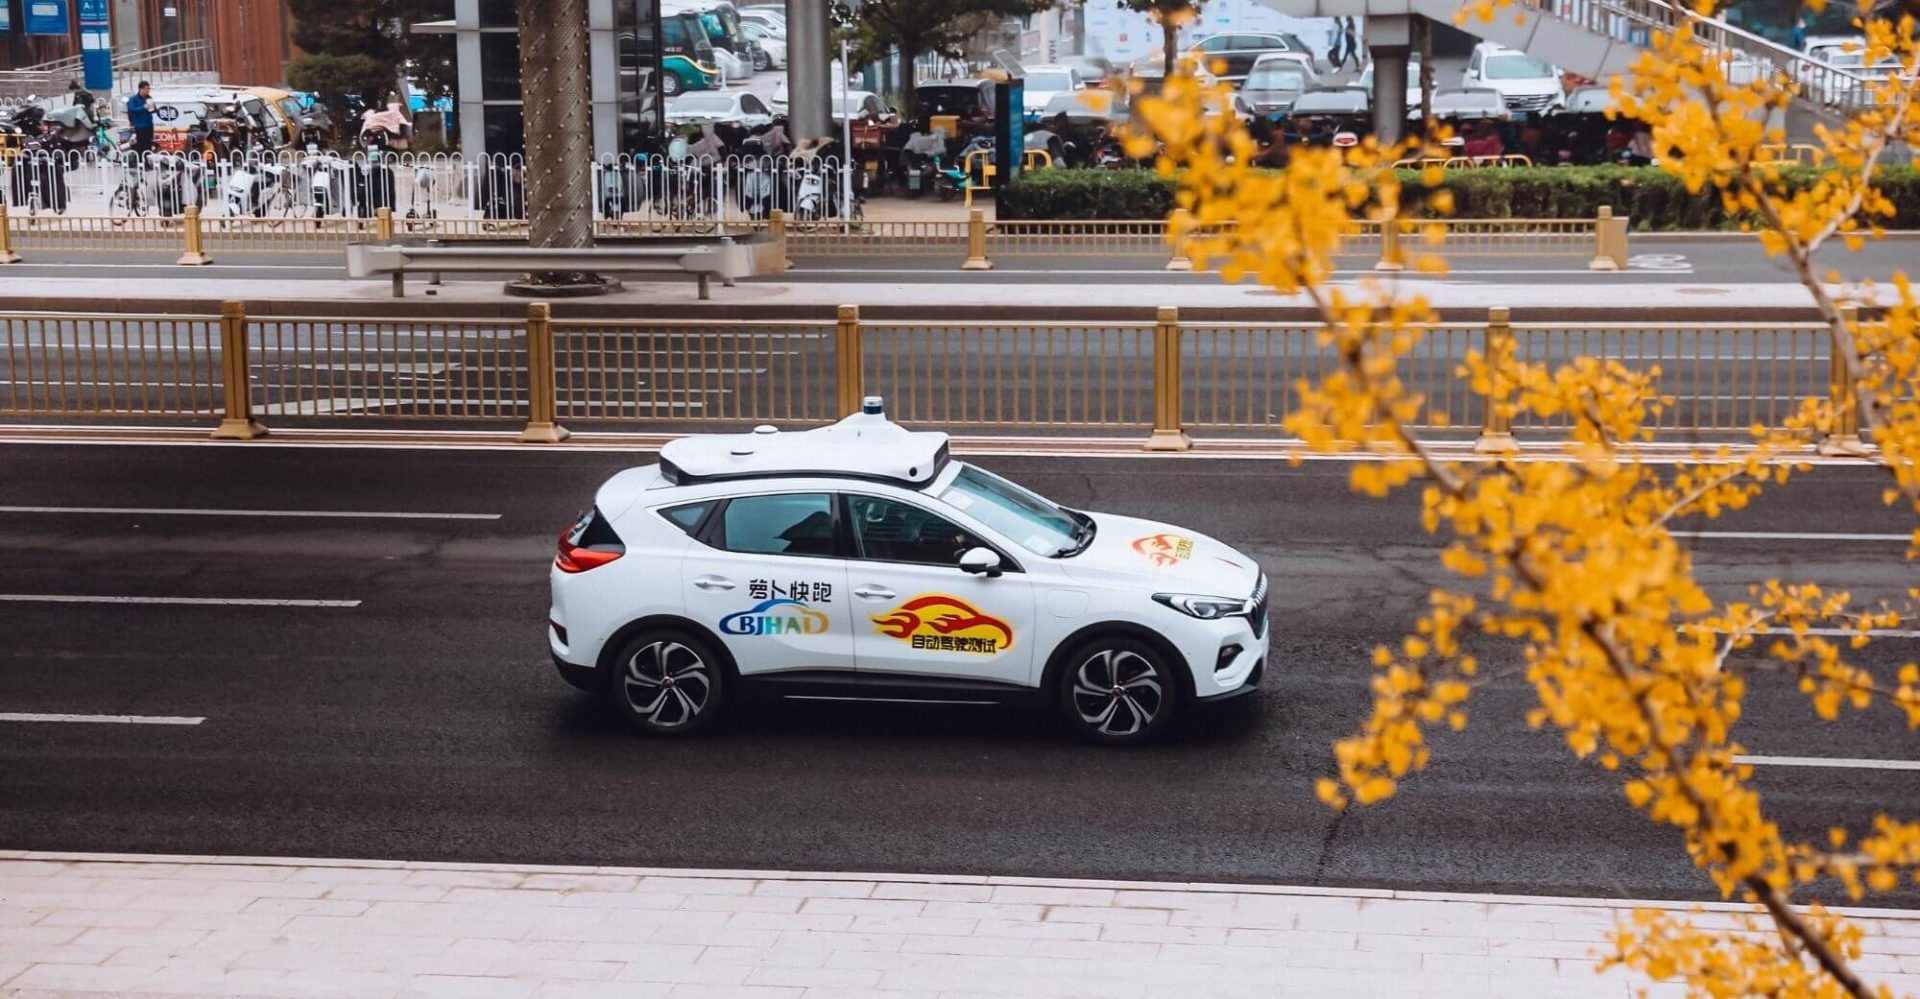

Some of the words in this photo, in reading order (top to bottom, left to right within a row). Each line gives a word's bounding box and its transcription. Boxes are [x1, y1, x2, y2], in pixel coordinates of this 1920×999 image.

[749, 579, 832, 602] 萝卜快跑
[738, 610, 829, 635] BJHAD
[912, 635, 996, 653] 自动驾驶测试
